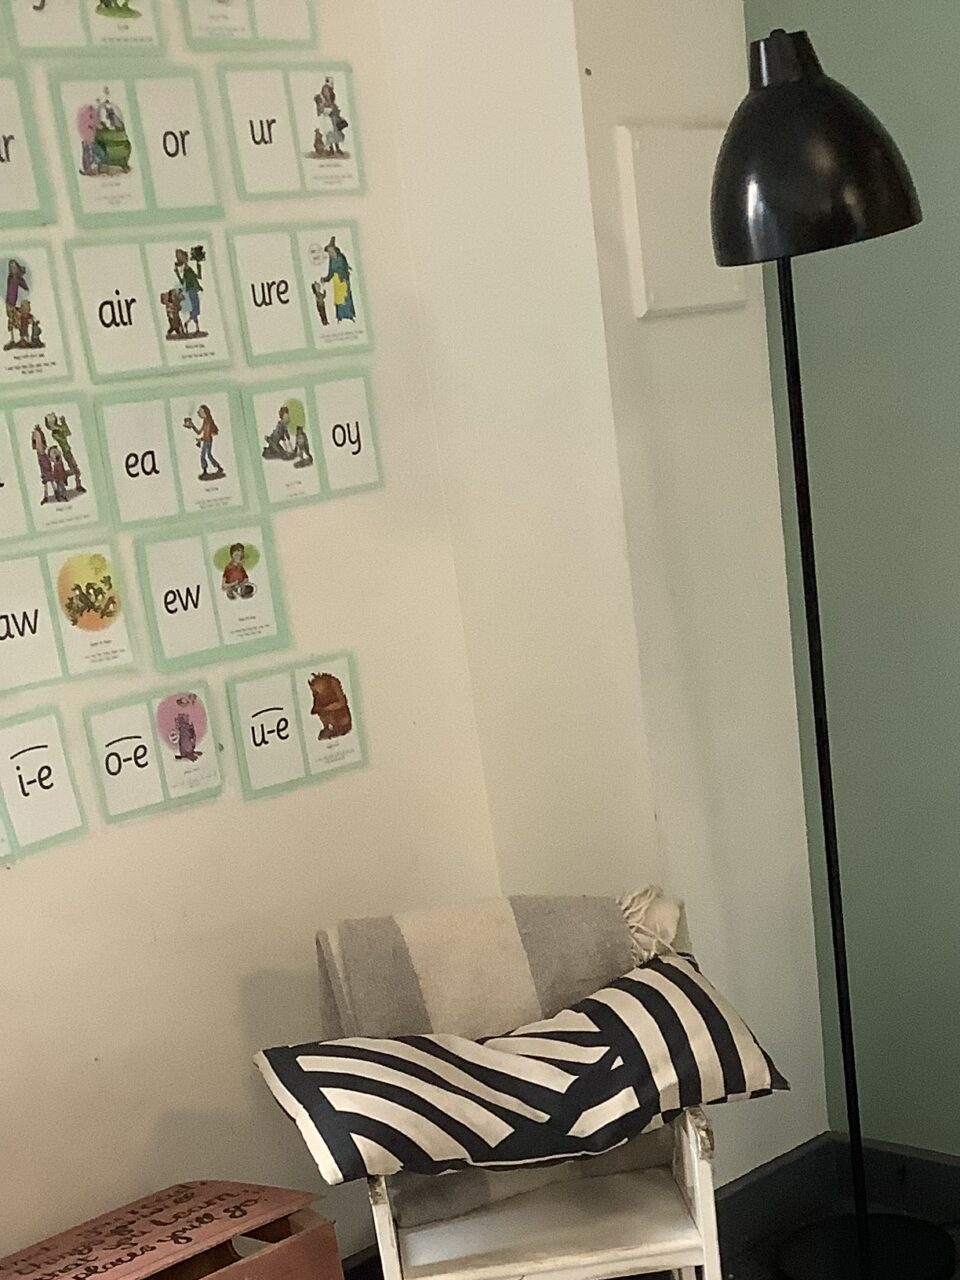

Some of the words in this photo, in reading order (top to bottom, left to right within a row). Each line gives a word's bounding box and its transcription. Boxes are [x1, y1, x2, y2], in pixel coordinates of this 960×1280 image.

[162, 129, 191, 158] or
[249, 118, 277, 146] ur
[250, 277, 291, 308] ure
[98, 288, 137, 329] air
[331, 419, 362, 454] oy
[124, 449, 160, 478] ea
[163, 584, 202, 615] ew
